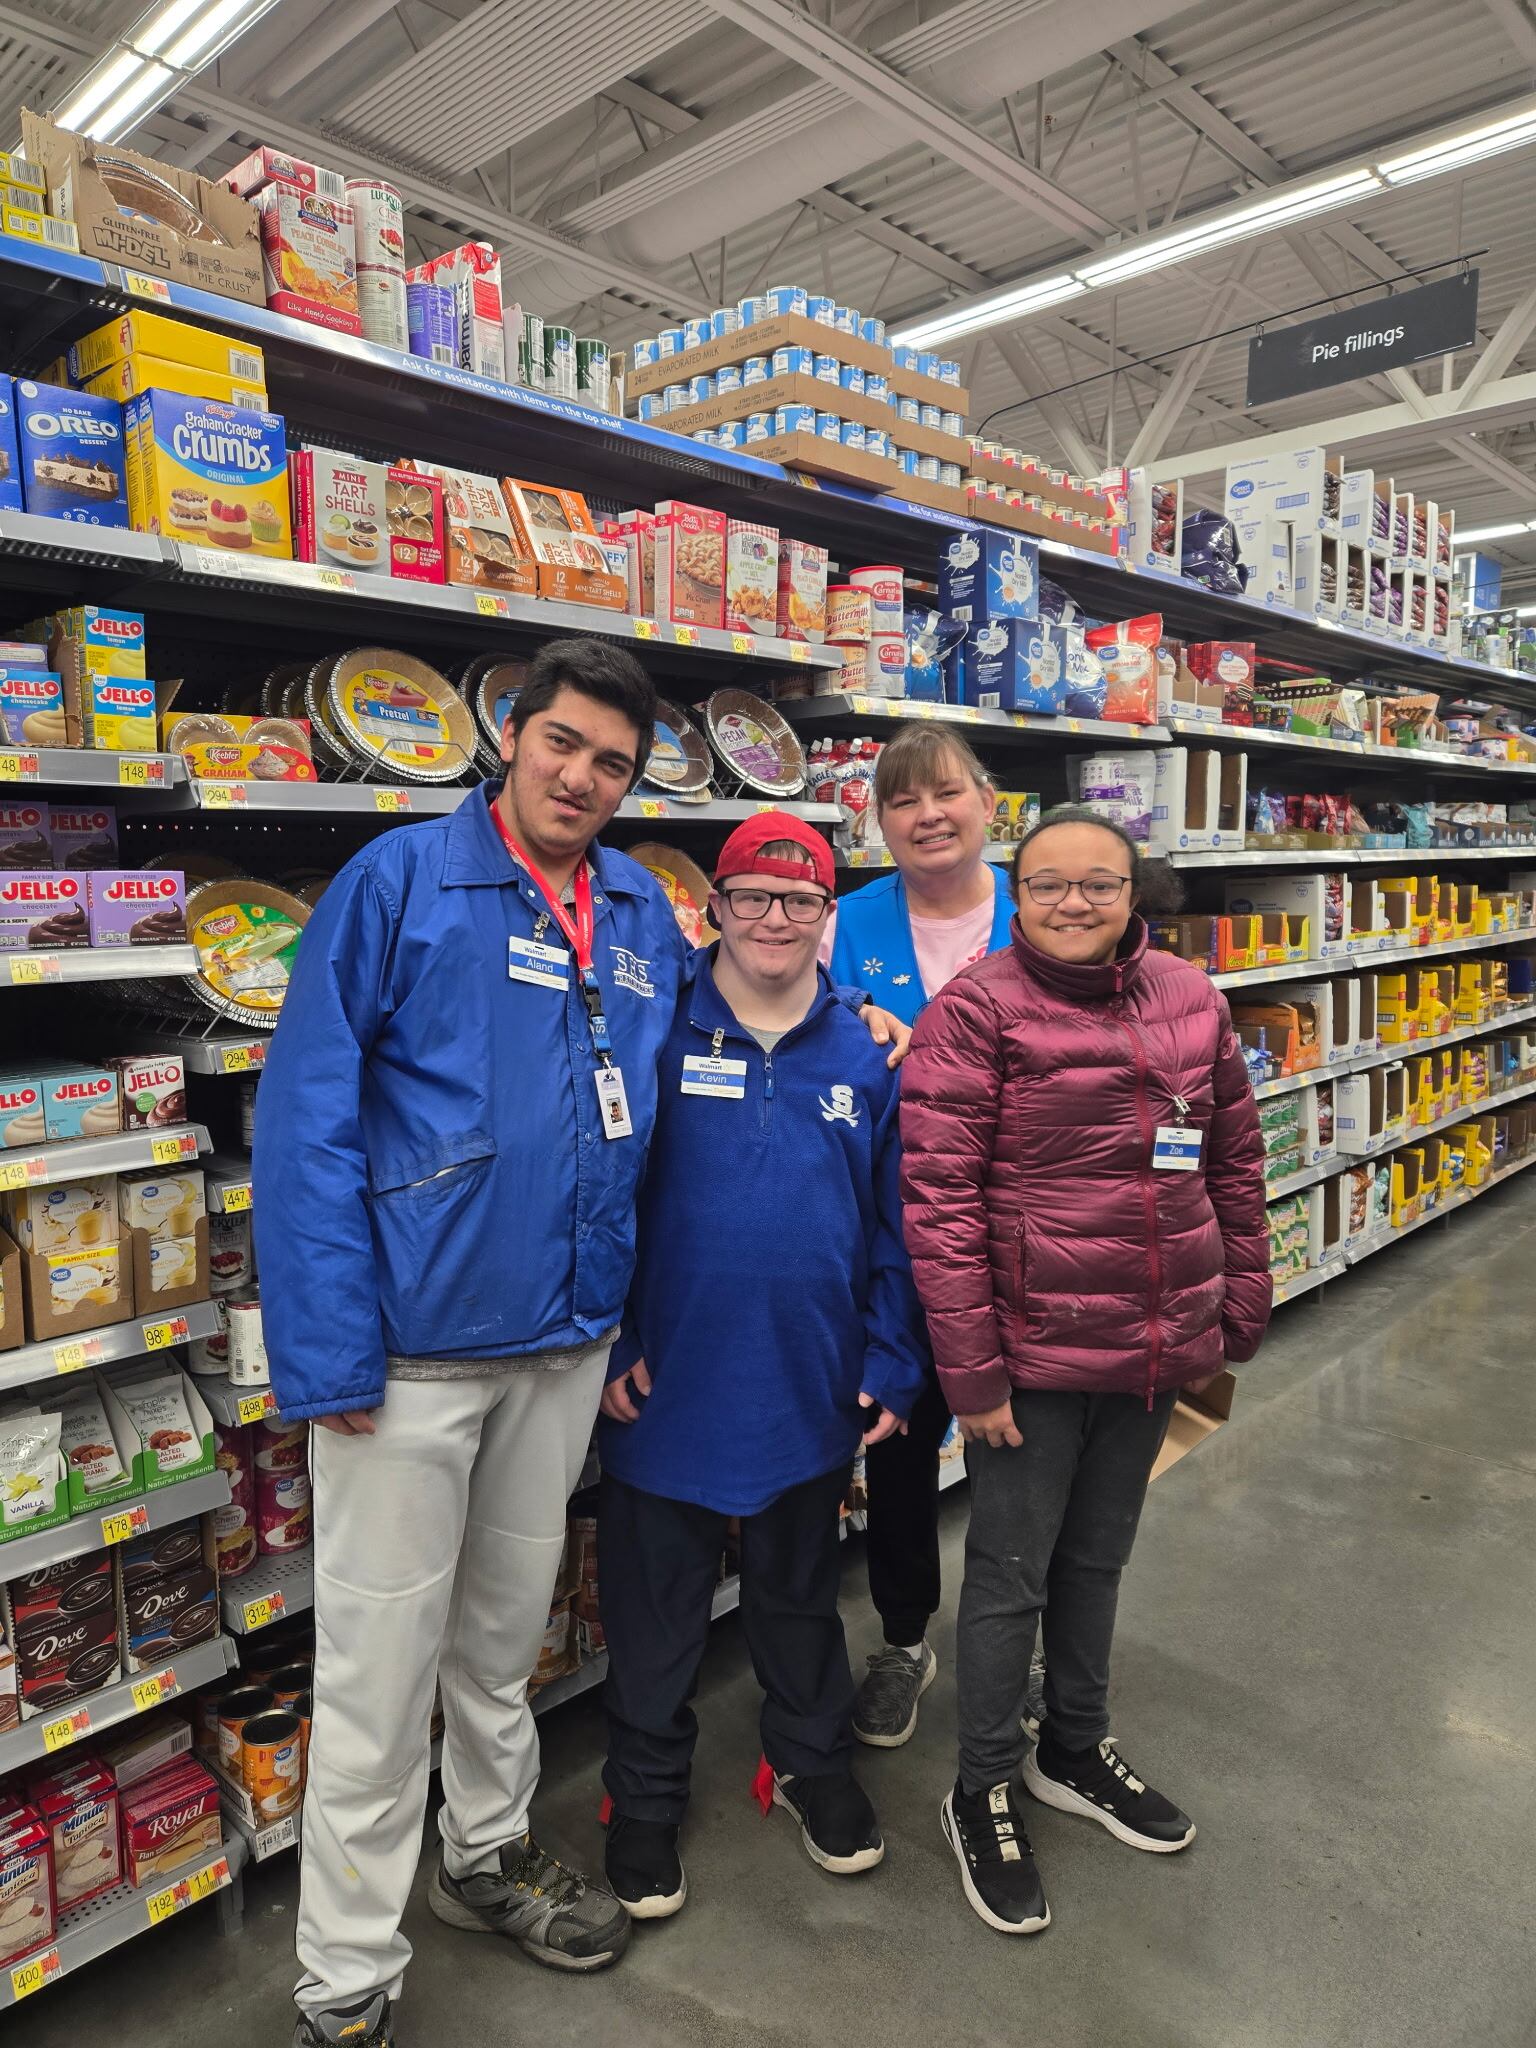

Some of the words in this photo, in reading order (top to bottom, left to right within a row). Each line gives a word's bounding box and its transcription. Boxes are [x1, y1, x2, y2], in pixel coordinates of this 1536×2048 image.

[198, 272, 216, 285] PIE
[217, 277, 252, 294] CRUST
[1312, 343, 1339, 363] Pie
[1345, 325, 1405, 354] fillings
[658, 351, 704, 377] EVAPORATED
[704, 345, 720, 360] MILK
[402, 357, 421, 372] Ask
[424, 364, 441, 379] for
[445, 370, 497, 394] assistance
[499, 384, 521, 401] with
[522, 391, 550, 409] items
[551, 403, 563, 414] on
[564, 404, 581, 419] the
[583, 410, 599, 425] top
[600, 414, 625, 430] shelf.
[73, 408, 92, 417] BAKE
[706, 407, 722, 422] MILK
[27, 413, 118, 438] OREO
[185, 411, 224, 432] graham
[225, 420, 263, 441] Cracker
[173, 424, 272, 472] Crumbs
[206, 469, 246, 484] ORIGINAL
[338, 473, 361, 483] MINI
[333, 481, 367, 500] TART
[325, 495, 375, 517] SHELLS
[463, 477, 485, 520] SHELLS
[476, 487, 492, 516] TART
[399, 546, 411, 560] 12
[606, 551, 626, 564] FFY
[460, 555, 471, 568] 12
[556, 571, 566, 583] 12
[107, 636, 126, 644] lemon
[116, 704, 136, 712] lemon
[379, 705, 410, 721] Pretzel
[720, 728, 748, 743] PECAN
[210, 749, 239, 761] Keebler
[203, 768, 247, 778] GRAHAM
[206, 918, 236, 935] Keebler
[524, 946, 547, 958] Walmart
[526, 957, 554, 973] Aland
[617, 952, 648, 983] SHS
[699, 1062, 722, 1071] Walmart
[698, 1072, 727, 1084] Kevin
[1169, 1145, 1184, 1155] Zoe
[62, 1253, 85, 1264] FAMILY
[86, 1251, 101, 1260] SIZE
[75, 1276, 97, 1287] Vanilla
[140, 1414, 164, 1425] pudding
[160, 1453, 187, 1464] ARAMEL
[147, 1477, 174, 1490] Natural
[175, 1464, 214, 1483] Ingredients
[72, 1500, 101, 1512] Natural
[102, 1486, 143, 1506] Ingredients
[10, 1500, 45, 1515] VANILLA
[0, 1527, 23, 1539] atural
[25, 1514, 69, 1534] Ingredients
[134, 1585, 189, 1620] Dove
[28, 1626, 88, 1661] Dove
[77, 1802, 92, 1812] Kraft
[63, 1801, 108, 1832] Minute
[147, 1796, 205, 1839] Royal
[67, 1815, 105, 1845] Tapioca
[6, 1857, 22, 1869] Kraft
[139, 1851, 156, 1860] Flan
[1, 1871, 36, 1899] apioca
